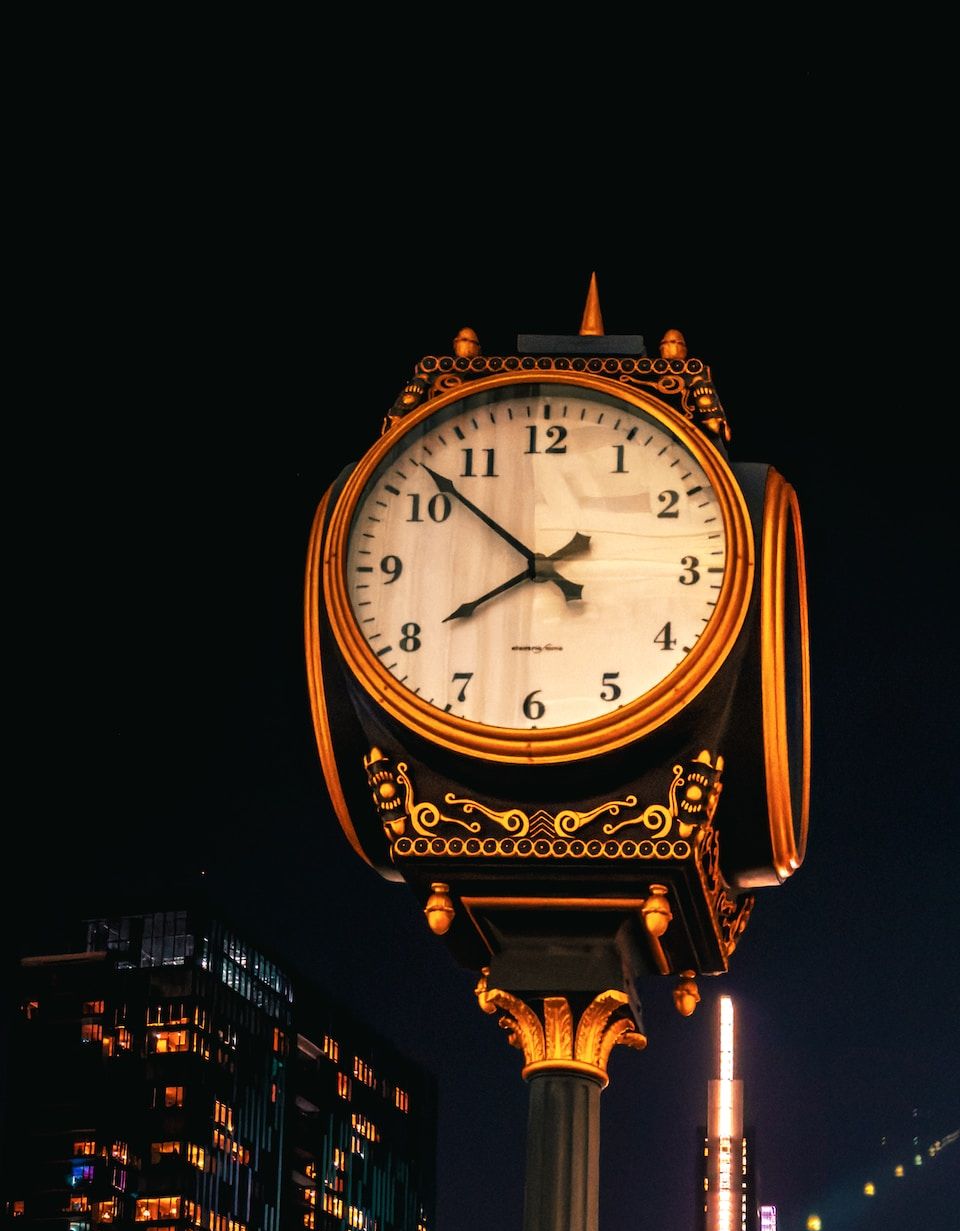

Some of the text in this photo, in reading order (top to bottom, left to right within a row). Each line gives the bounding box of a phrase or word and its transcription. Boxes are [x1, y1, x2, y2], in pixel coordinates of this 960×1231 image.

[523, 425, 568, 454] 12
[459, 448, 500, 478] 11
[609, 444, 630, 474] 1
[405, 492, 452, 523] 10
[656, 489, 680, 519] 2
[379, 555, 403, 585] 9
[678, 556, 701, 586] 3
[399, 622, 422, 652] 8
[653, 621, 678, 651] 4
[450, 672, 474, 702] 7
[599, 671, 622, 702] 5
[522, 690, 546, 720] 6
